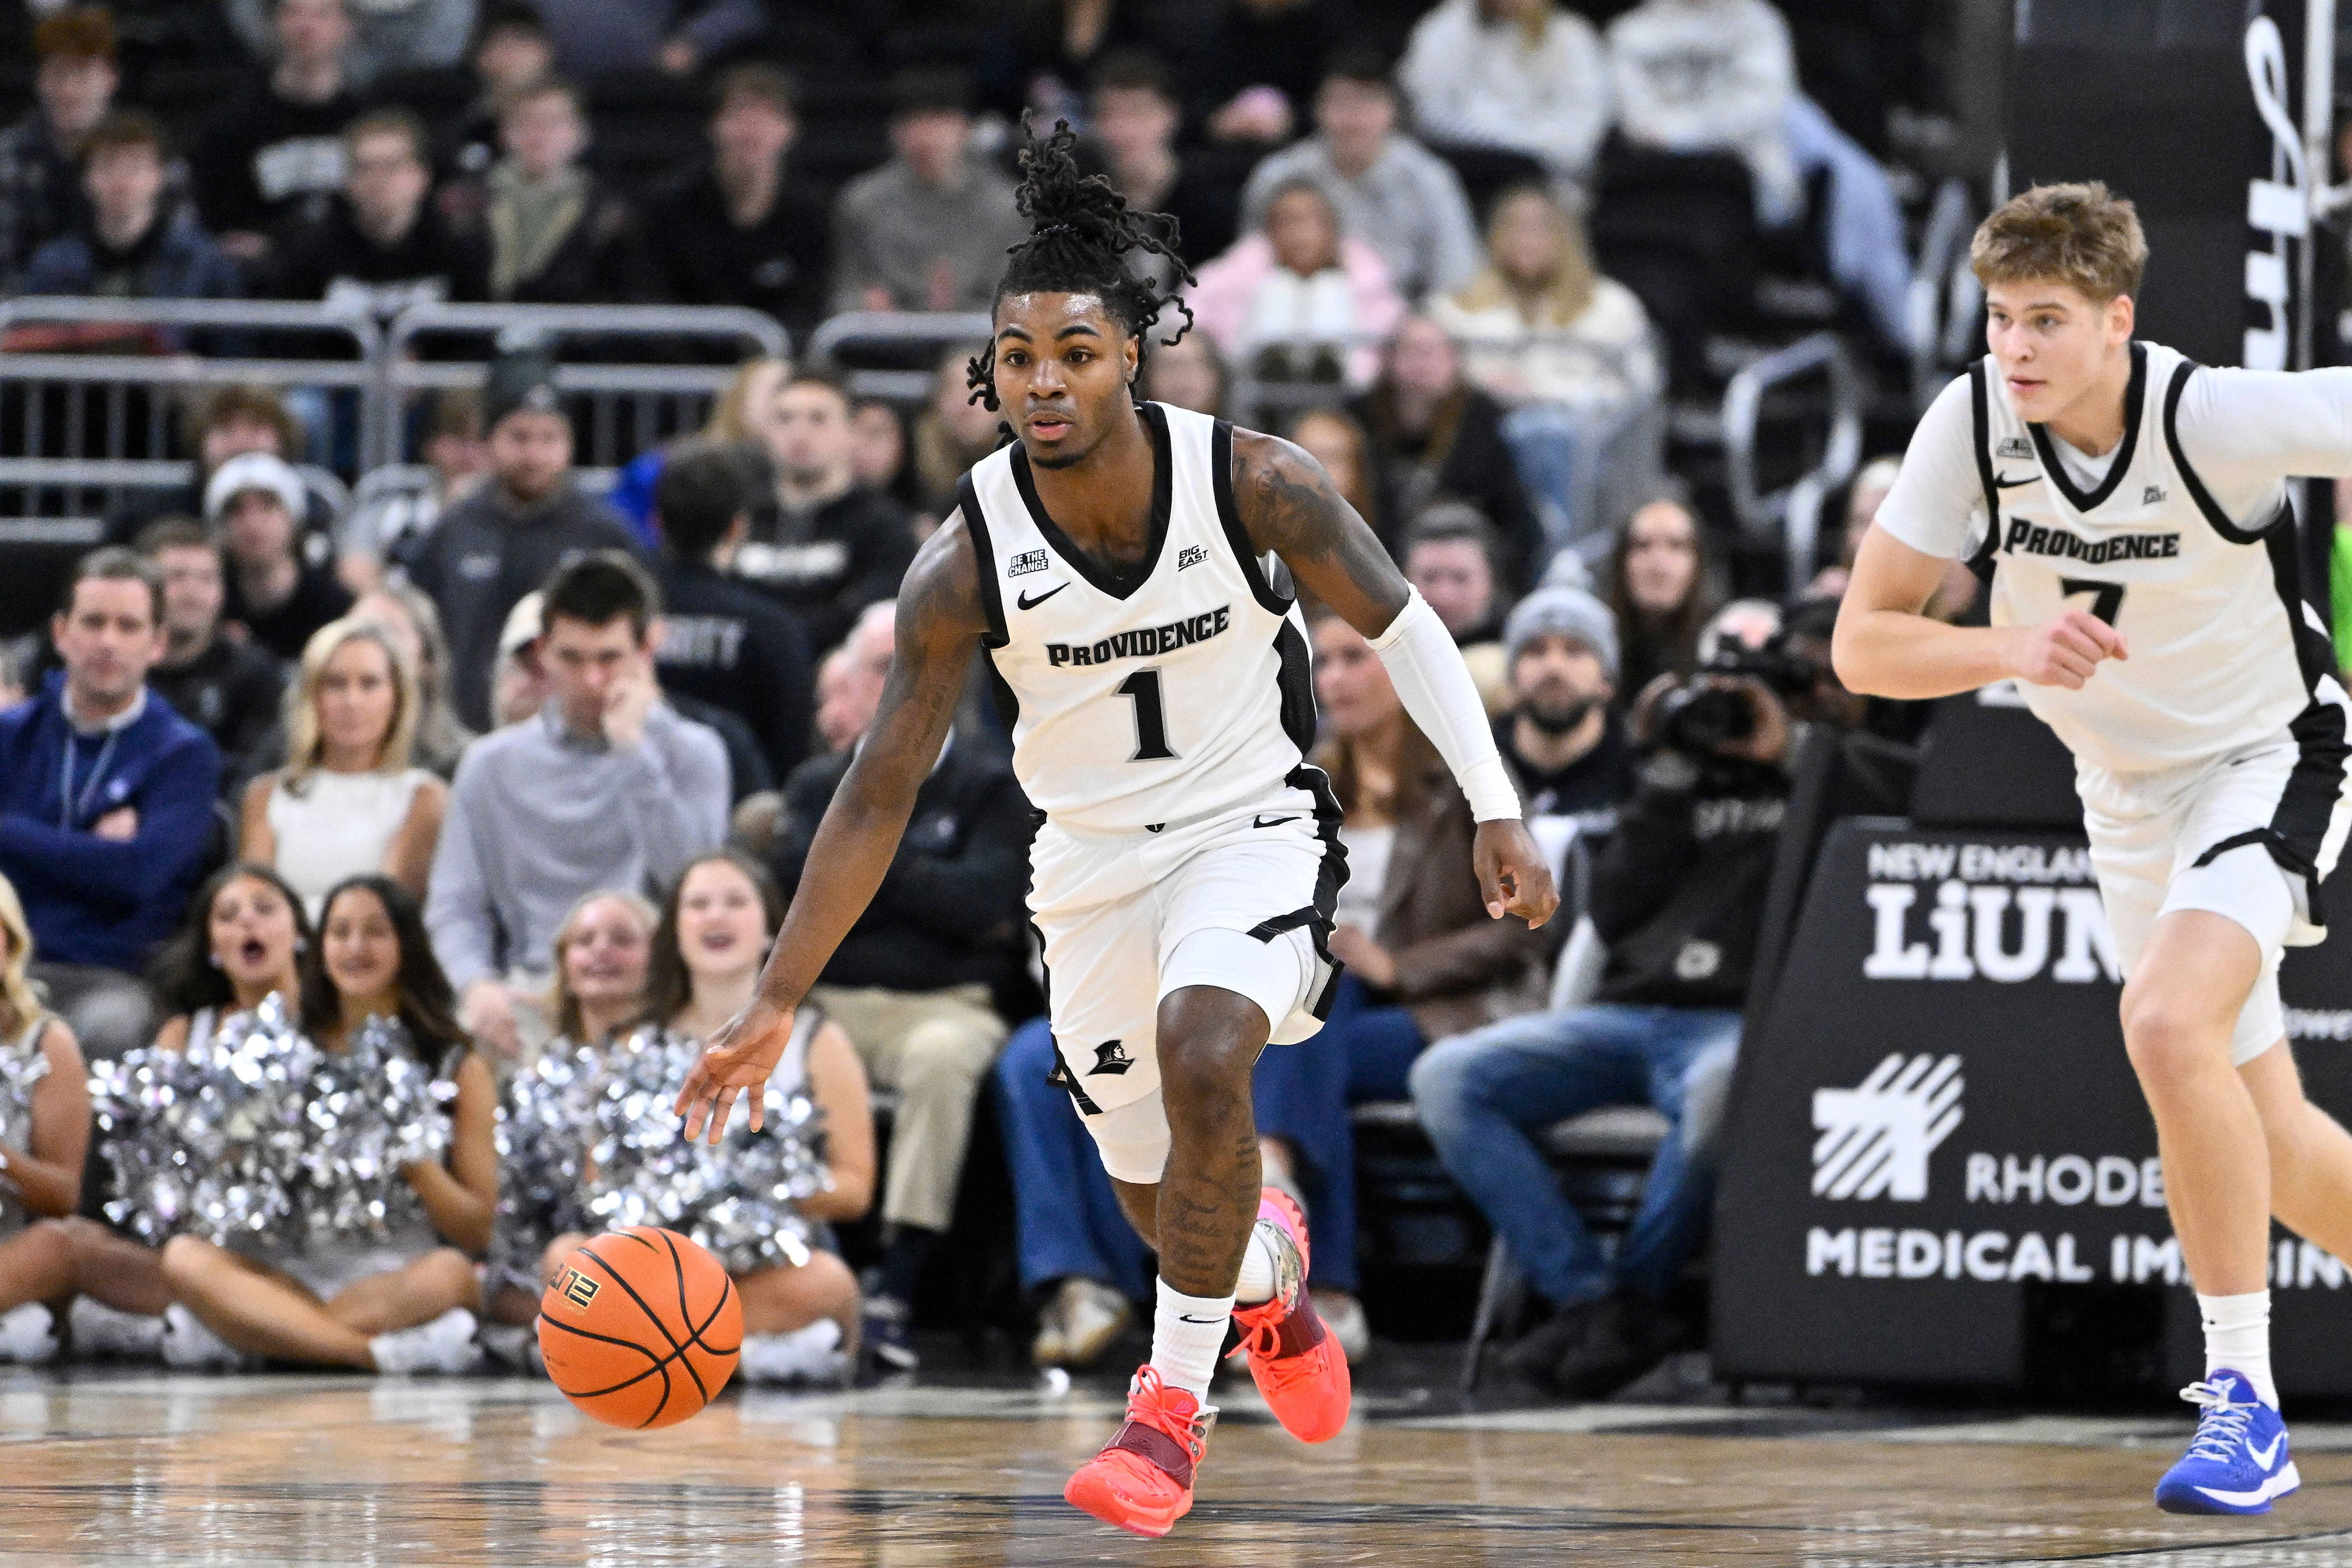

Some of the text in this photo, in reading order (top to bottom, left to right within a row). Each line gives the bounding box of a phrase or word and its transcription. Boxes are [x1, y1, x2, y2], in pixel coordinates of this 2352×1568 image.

[1011, 549, 1045, 567] BE THE
[1178, 549, 1209, 568] EAST
[1179, 544, 1200, 560] BIG
[2003, 515, 2181, 565] PROVIDENCE
[1009, 559, 1048, 577] CHANGE
[1045, 604, 1230, 668] PROVIDENCE
[1110, 666, 1182, 762] 1
[1867, 842, 2099, 883] NEW ENGLAN
[1863, 879, 2123, 984] LiUN
[1965, 1153, 2168, 1209] RHODE
[1806, 1227, 2343, 1290] MEDICAL IMIN
